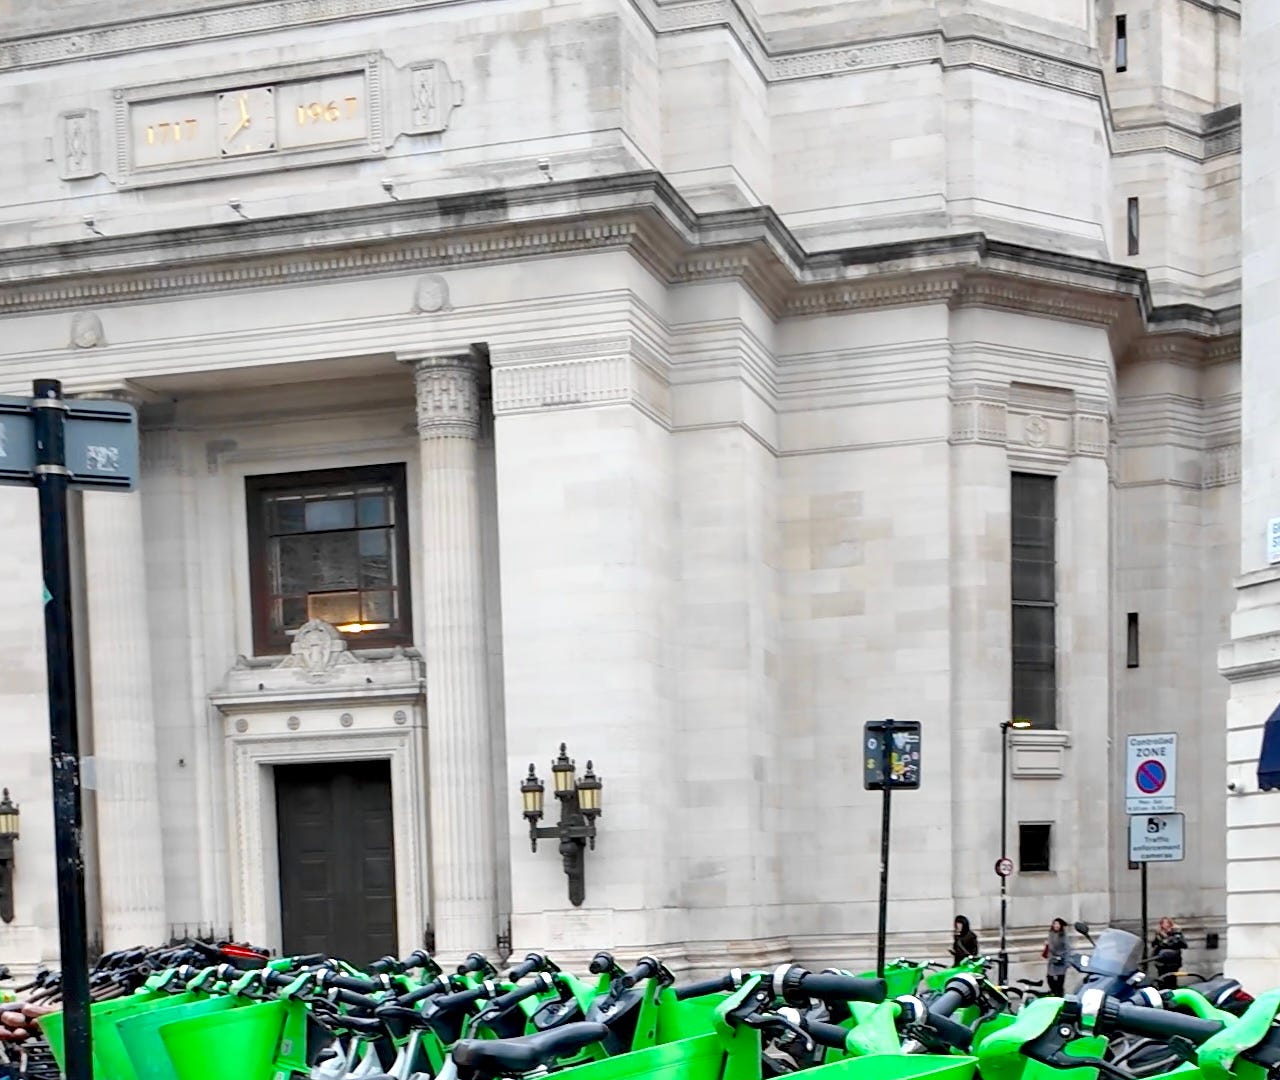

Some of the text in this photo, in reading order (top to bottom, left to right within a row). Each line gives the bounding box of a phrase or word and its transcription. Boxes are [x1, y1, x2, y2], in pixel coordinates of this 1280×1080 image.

[297, 97, 357, 126] 1967
[146, 118, 197, 145] 1717
[1130, 738, 1174, 746] Controlled
[1136, 747, 1167, 757] ZONE
